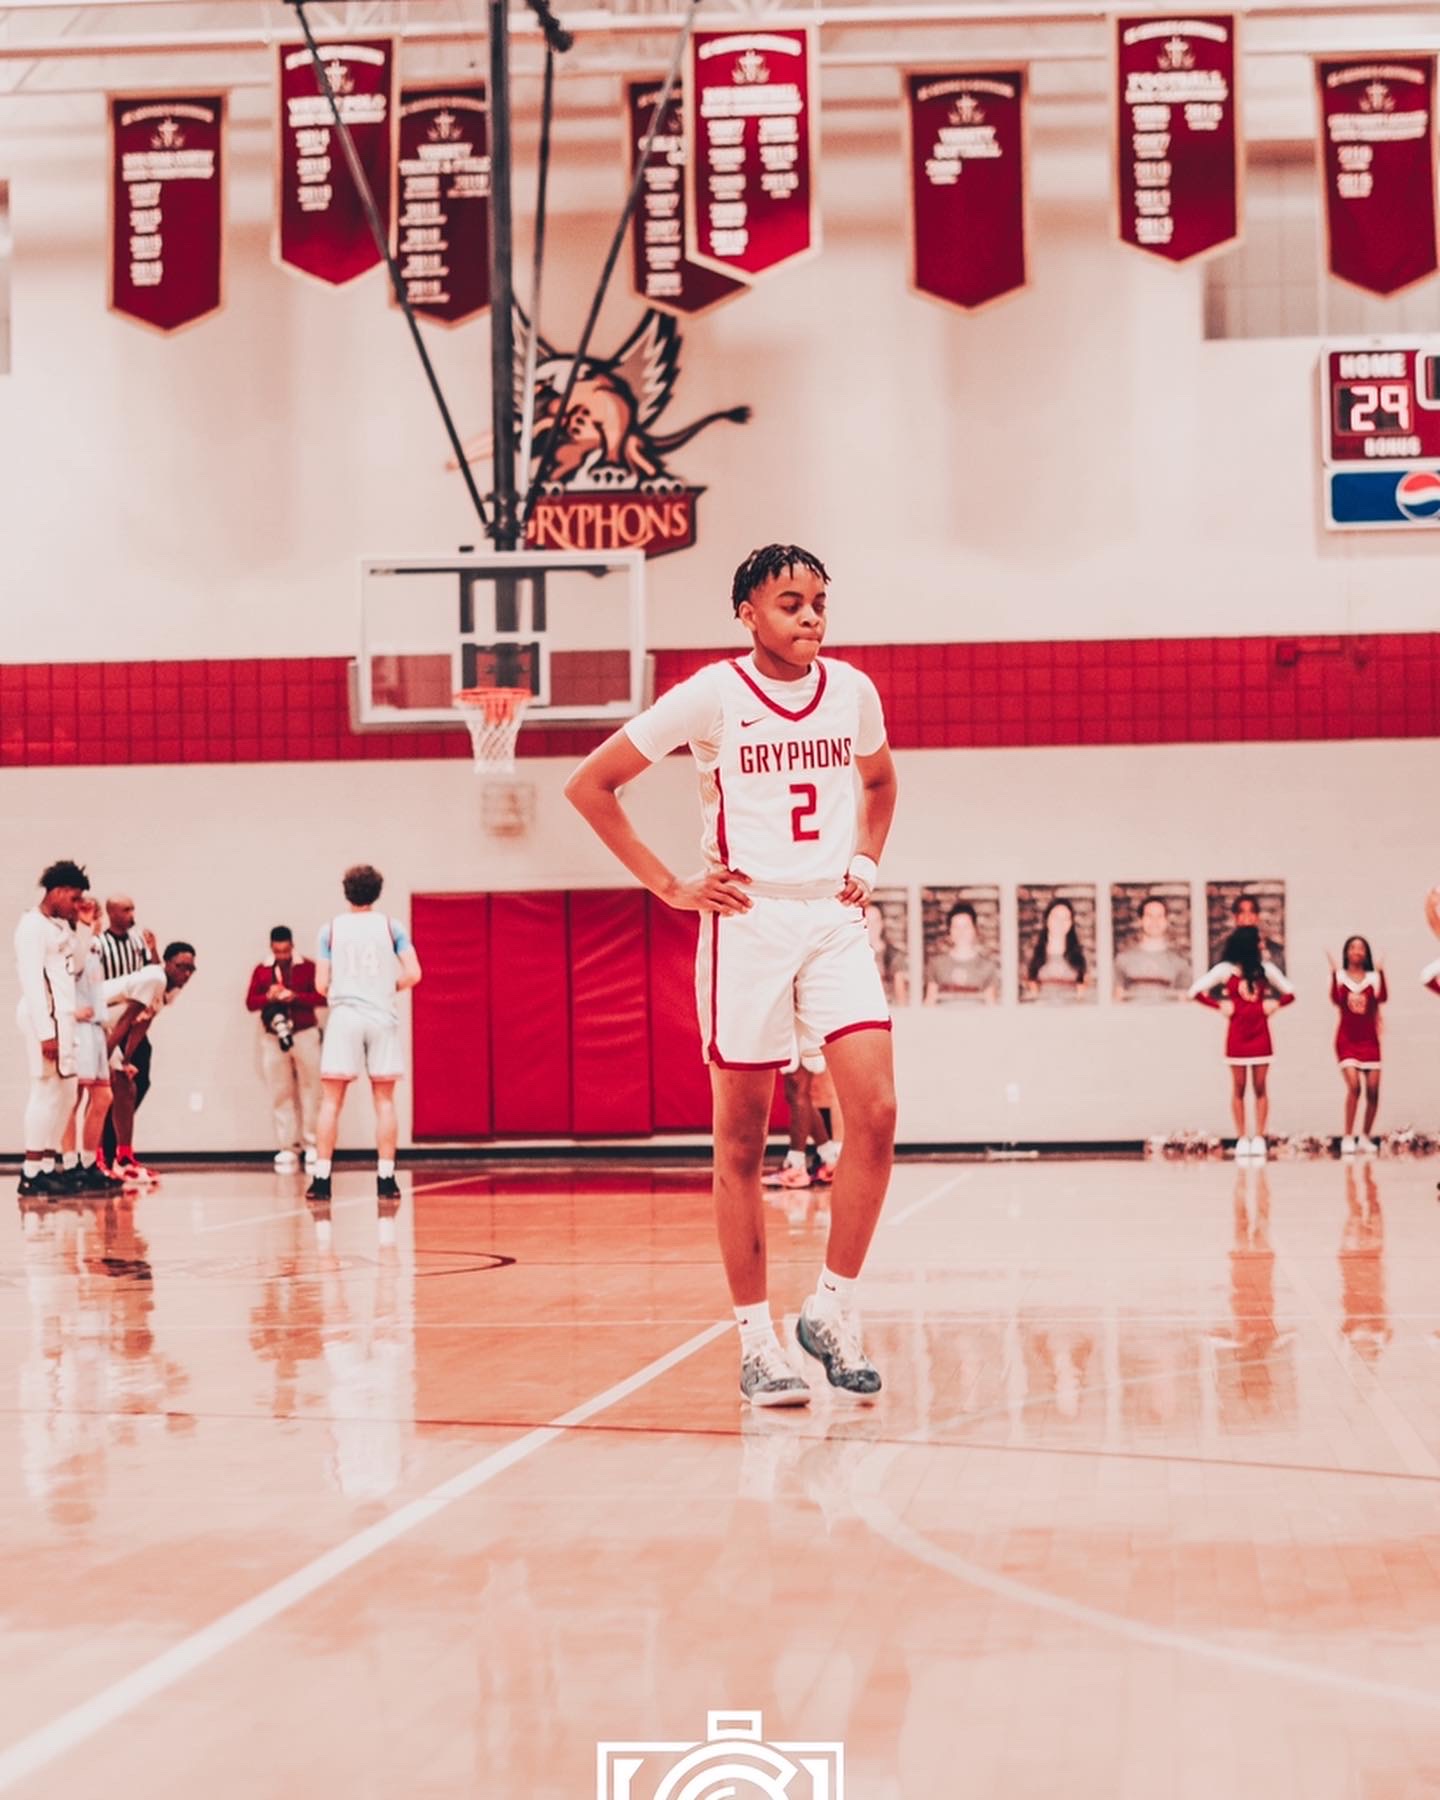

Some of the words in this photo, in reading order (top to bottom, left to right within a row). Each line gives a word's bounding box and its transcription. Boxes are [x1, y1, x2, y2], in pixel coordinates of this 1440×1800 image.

[1351, 386, 1409, 432] 29
[740, 738, 851, 773] GRYPHONS
[790, 783, 819, 842] 2
[343, 939, 383, 978] 14
